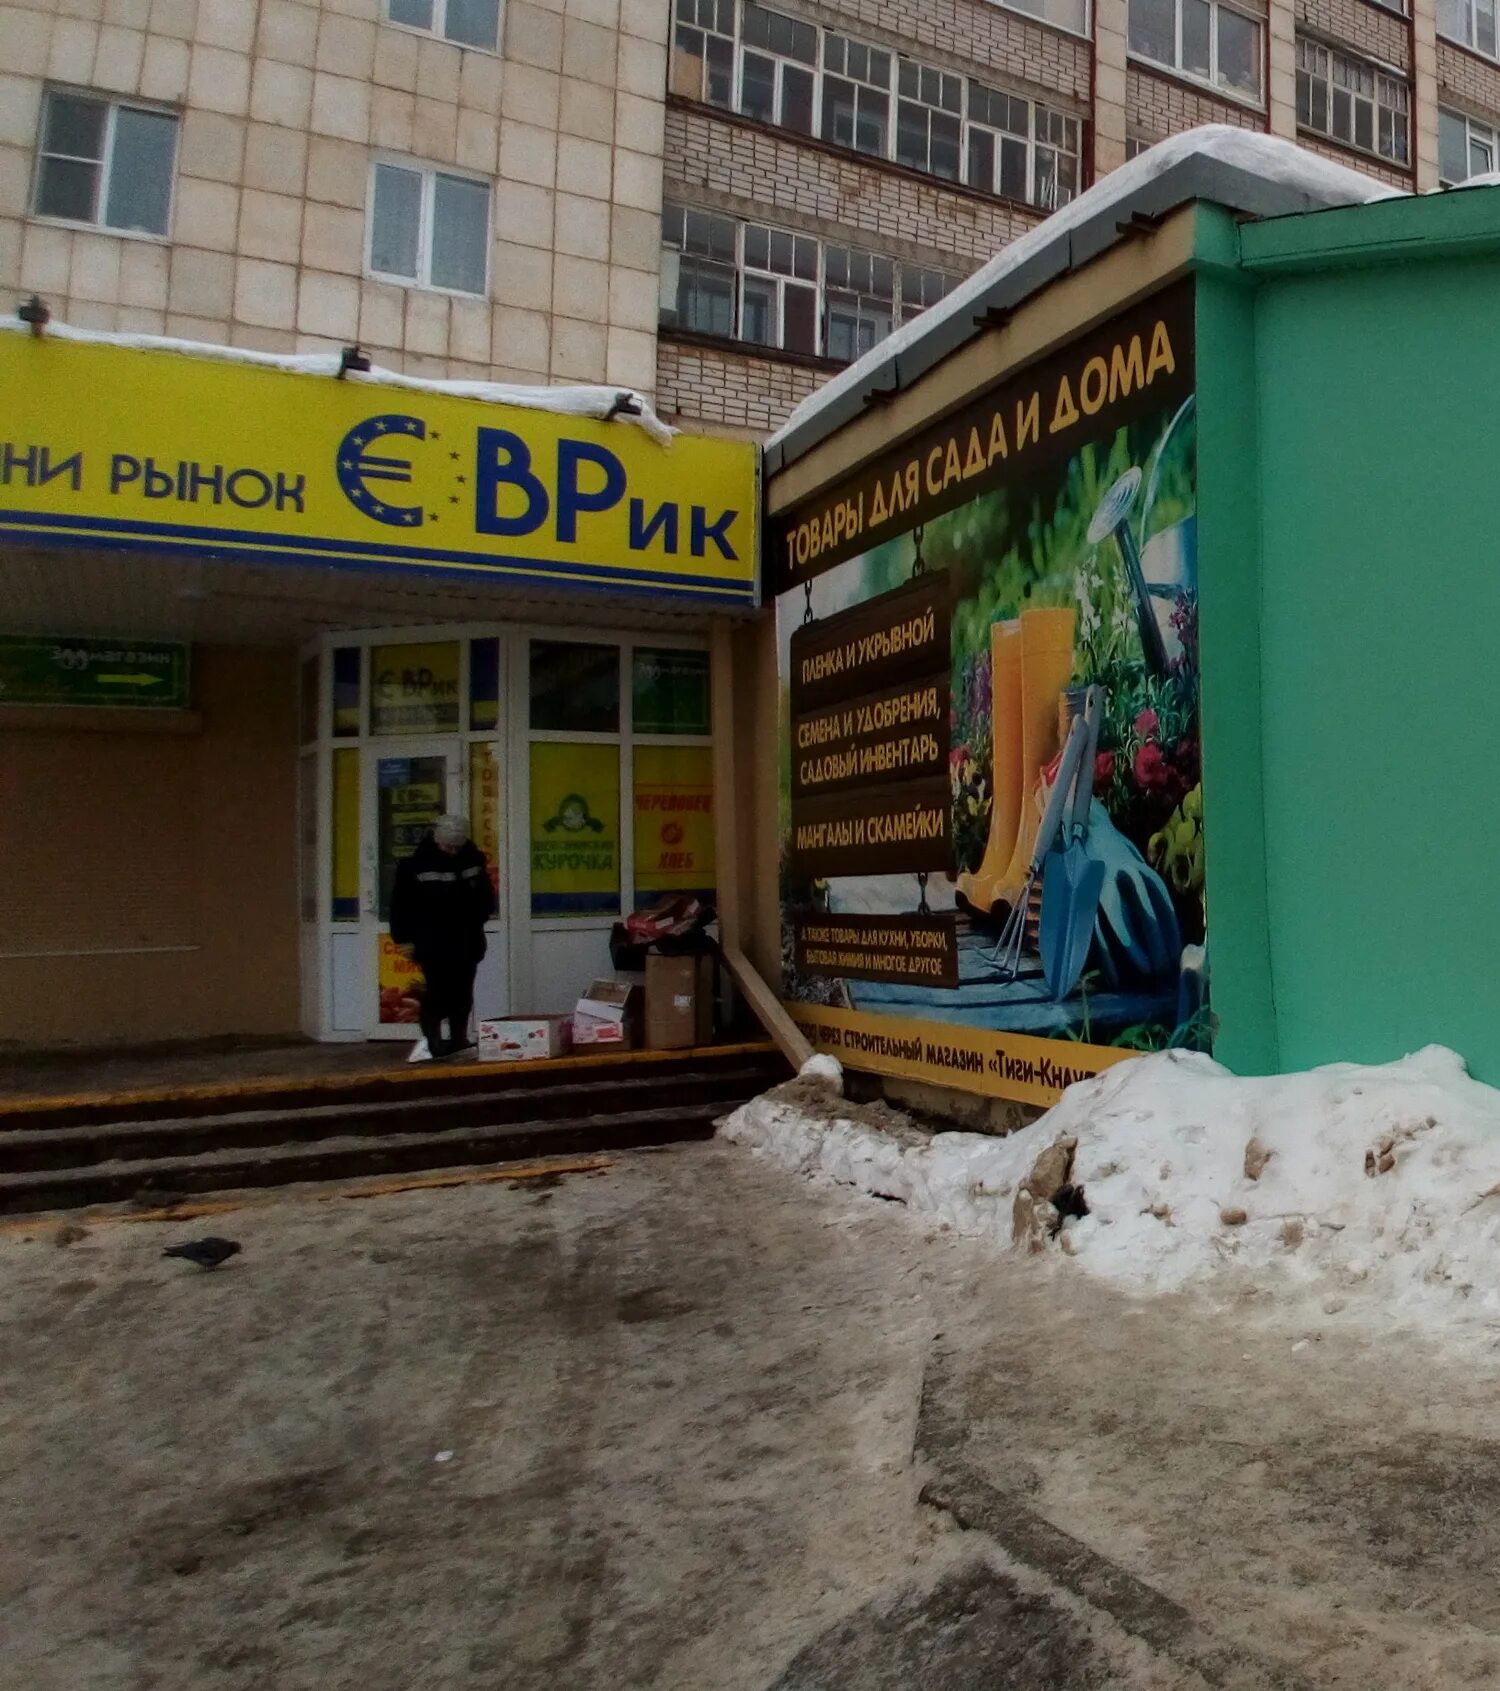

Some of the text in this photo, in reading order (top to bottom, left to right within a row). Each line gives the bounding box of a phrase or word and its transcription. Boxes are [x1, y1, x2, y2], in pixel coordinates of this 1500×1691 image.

[786, 319, 1176, 571] ТОВАРЫ ДЛЯ САДА И ДОМА
[110, 453, 306, 514] РЫНОК
[802, 606, 935, 685] ПЛЕНКА И УКРЫВНОЙ
[798, 687, 942, 749] СЕМЕНА И УДОБРЕНИЯ,
[800, 733, 939, 786] САДОВЫЙ ИНВЕНТАРЬ
[797, 803, 944, 850] МАНГАЛЫ И СКАМЕЙКИ
[533, 853, 614, 871] КУРОЧКА
[831, 928, 861, 945] ТОВАРЫ
[861, 929, 879, 946] ДЛЯ
[806, 949, 943, 976] БЫТОВАЯ ХИМИЯ И МНОГОЕ ДРУГОЕ
[844, 1029, 923, 1062] СТРОИТЕЛЬНЫЙ
